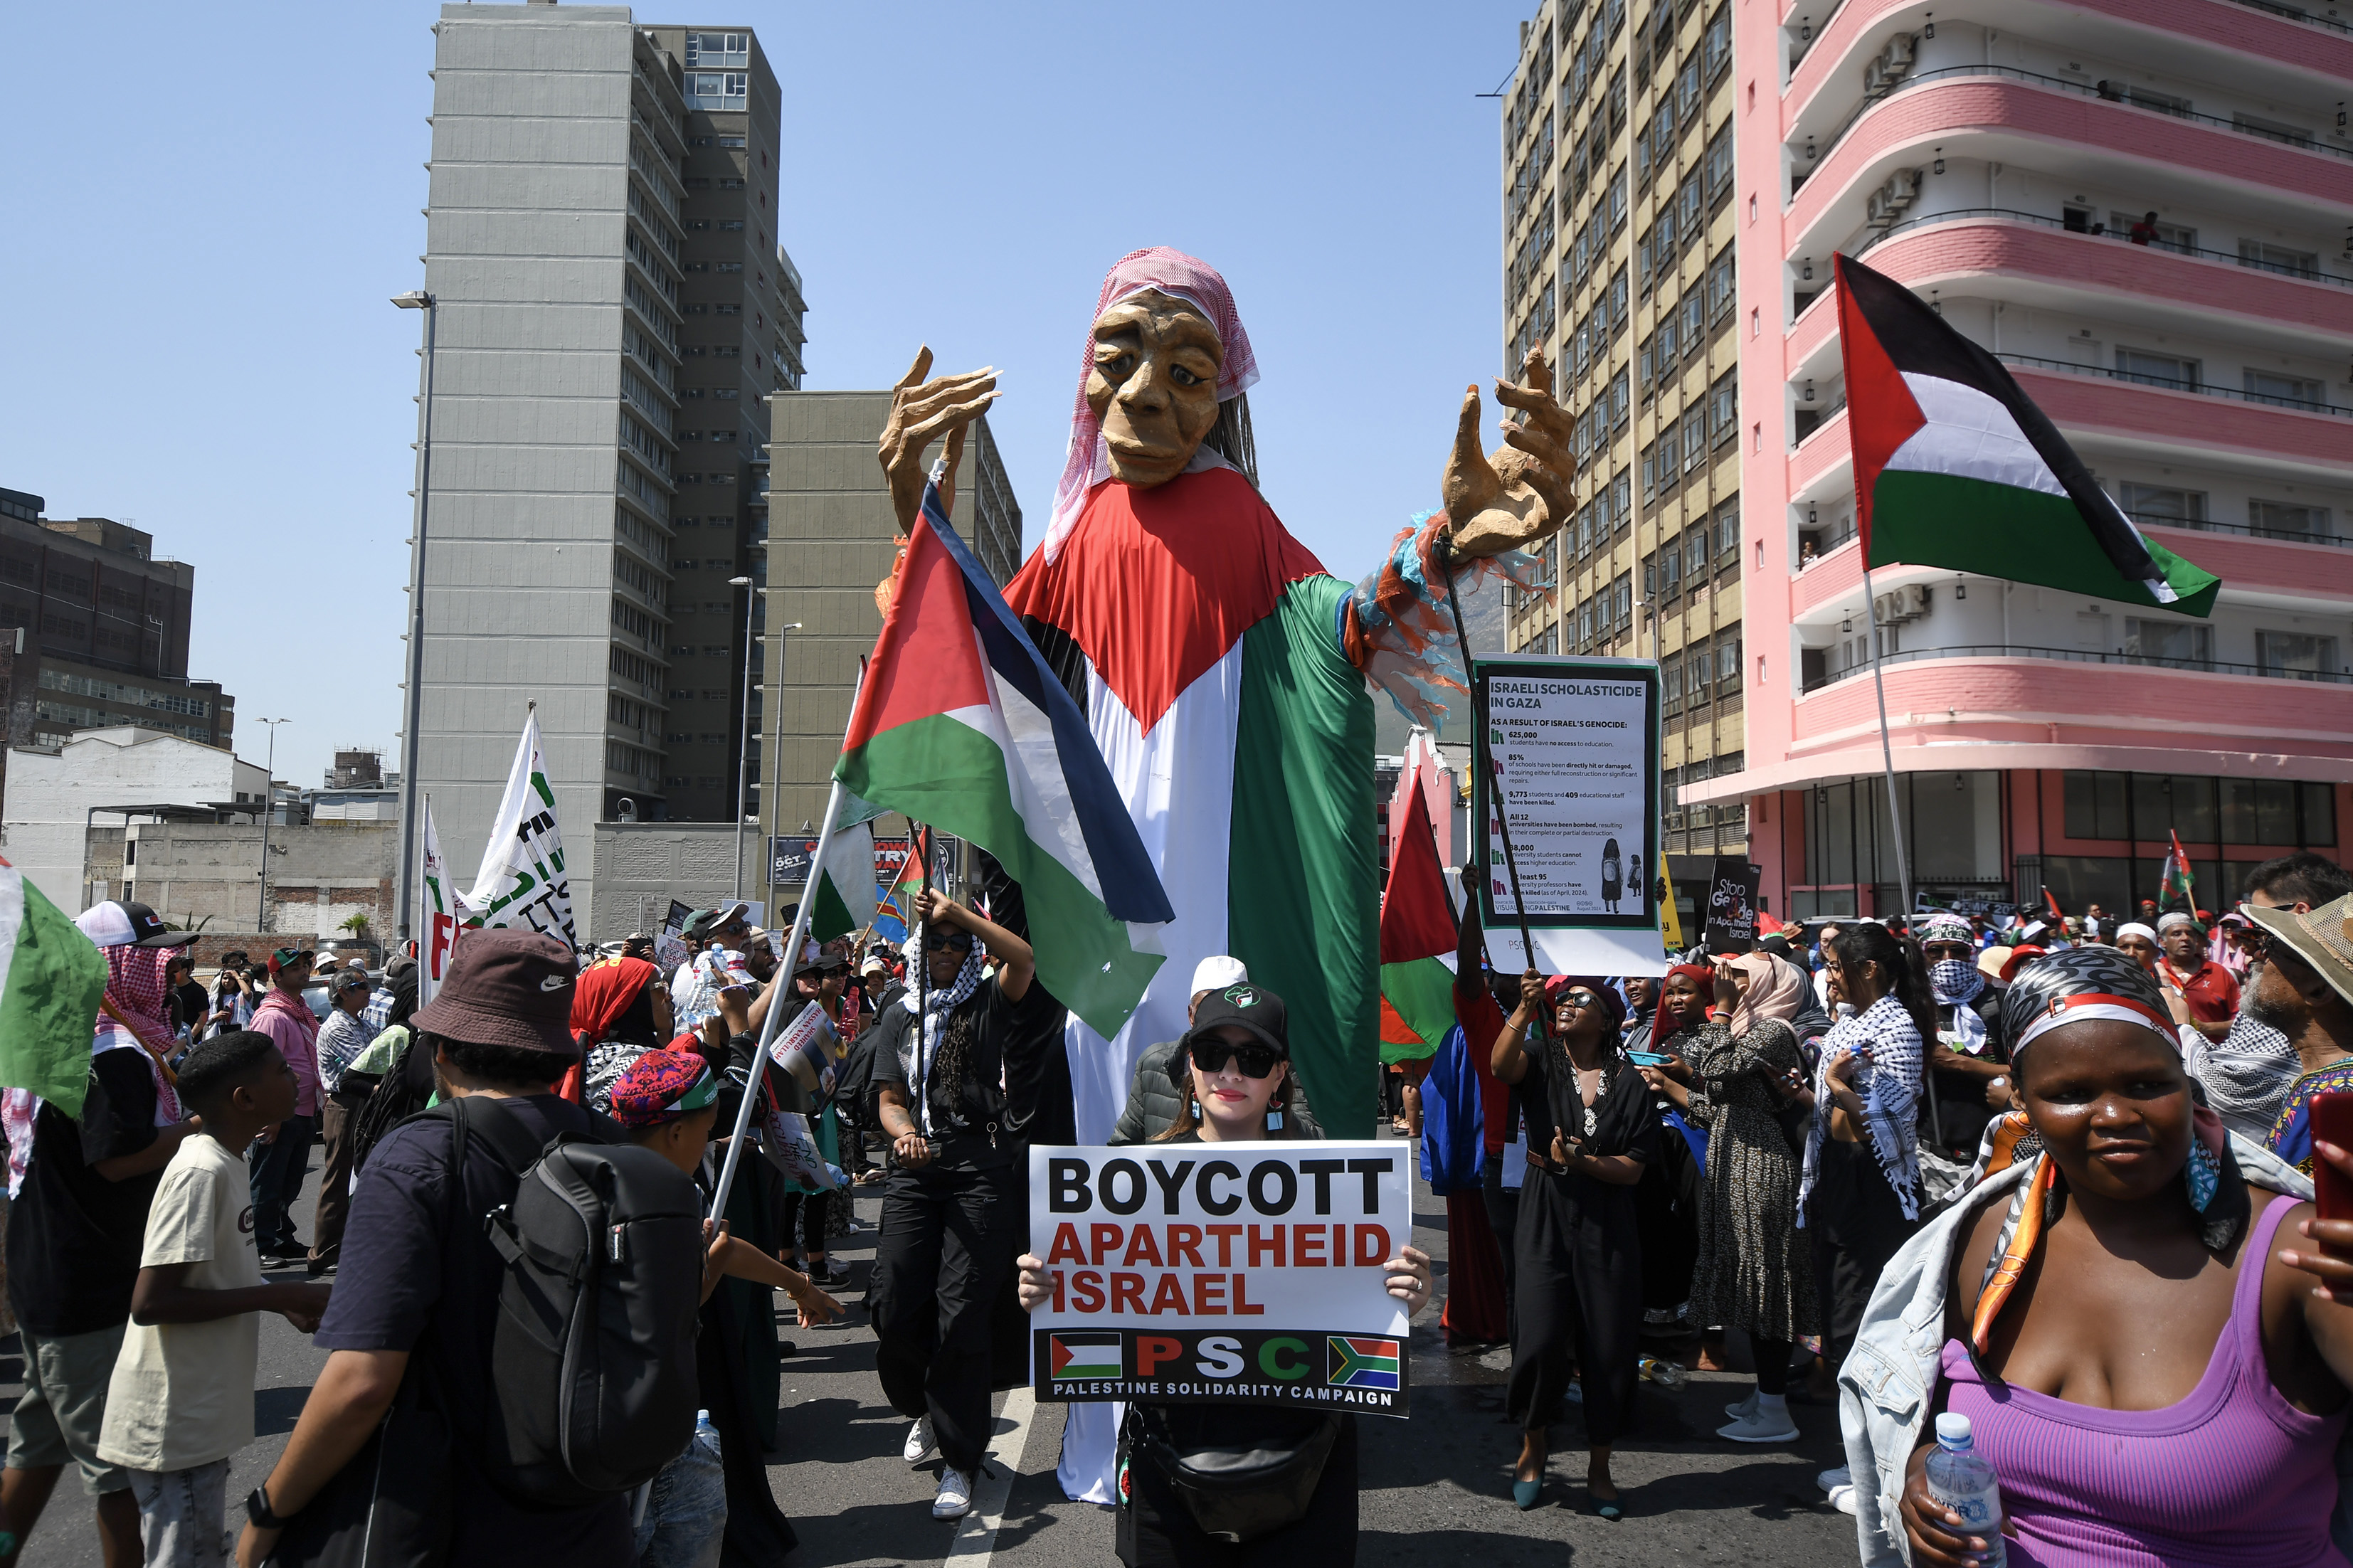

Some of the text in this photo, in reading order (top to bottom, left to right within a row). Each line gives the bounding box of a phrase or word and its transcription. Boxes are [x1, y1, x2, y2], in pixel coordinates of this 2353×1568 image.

[2328, 9, 2337, 17] 602
[2336, 129, 2345, 137] 502
[1491, 682, 1642, 697] ISRAELI SCHOLASTICIDE
[1491, 697, 1541, 709] IN GAZA
[776, 855, 800, 867] OCT
[784, 861, 806, 869] STADIUM
[1720, 878, 1745, 896] Stop
[1709, 915, 1715, 924] in
[1729, 927, 1751, 939] Israel
[667, 948, 679, 956] FIGHT
[546, 974, 565, 986] NIKE
[774, 1007, 822, 1060] HASSAN NASRULLAH
[793, 1026, 817, 1051] SHAHEED
[789, 1143, 804, 1162] THE
[796, 1137, 817, 1169] END
[1049, 1158, 1393, 1216] BOYCOTT
[1047, 1222, 1391, 1267] APARTHEID
[1052, 1270, 1265, 1316] ISRAEL
[1136, 1336, 1310, 1380] PSC
[1054, 1382, 1392, 1407] PALESTINE SOLIDARITY CAMPAIGN
